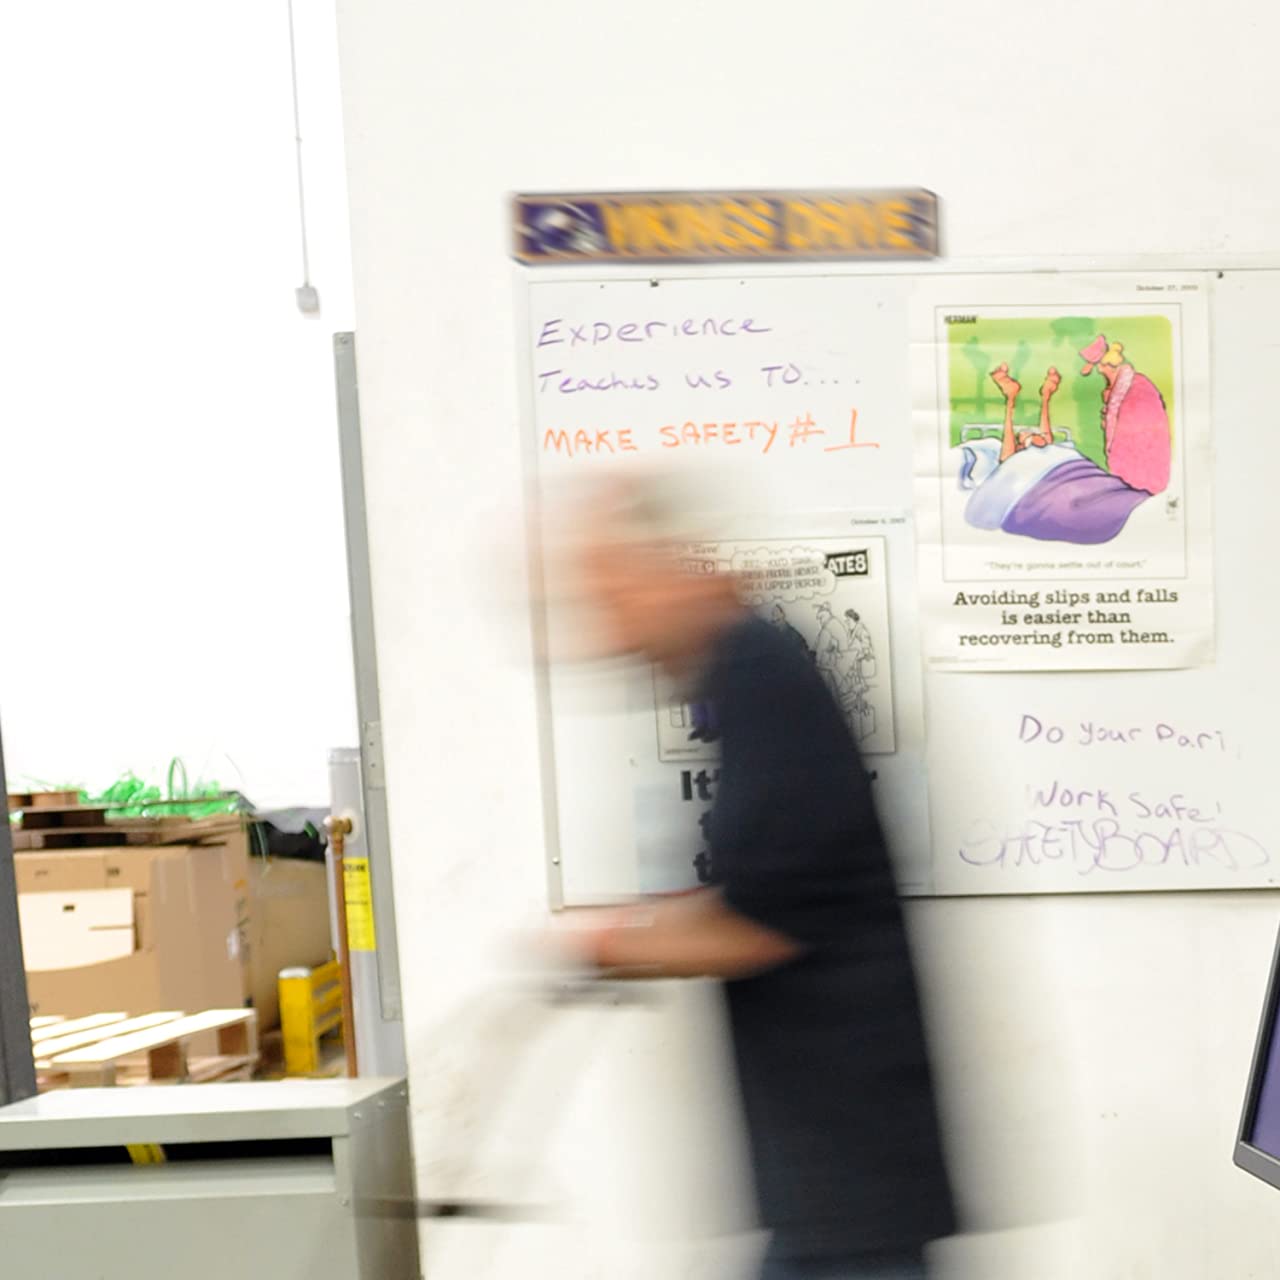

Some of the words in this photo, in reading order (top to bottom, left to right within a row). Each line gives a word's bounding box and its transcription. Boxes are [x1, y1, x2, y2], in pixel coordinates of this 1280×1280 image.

[537, 316, 773, 349] Experience
[537, 369, 660, 395] Teaches
[685, 371, 732, 390] us
[543, 427, 639, 457] MAKE
[658, 419, 779, 454] SAFETY
[826, 554, 867, 575] ATE8
[954, 590, 1040, 608] Avoiding
[1044, 588, 1091, 607] slips
[1096, 588, 1132, 605] and
[1136, 587, 1179, 604] falls
[1001, 609, 1018, 626] is
[1023, 609, 1083, 626] easier
[1087, 609, 1132, 625] than
[958, 629, 1063, 649] recovering
[1067, 628, 1115, 645] from
[1119, 628, 1176, 645] them.
[1018, 714, 1065, 744] Do
